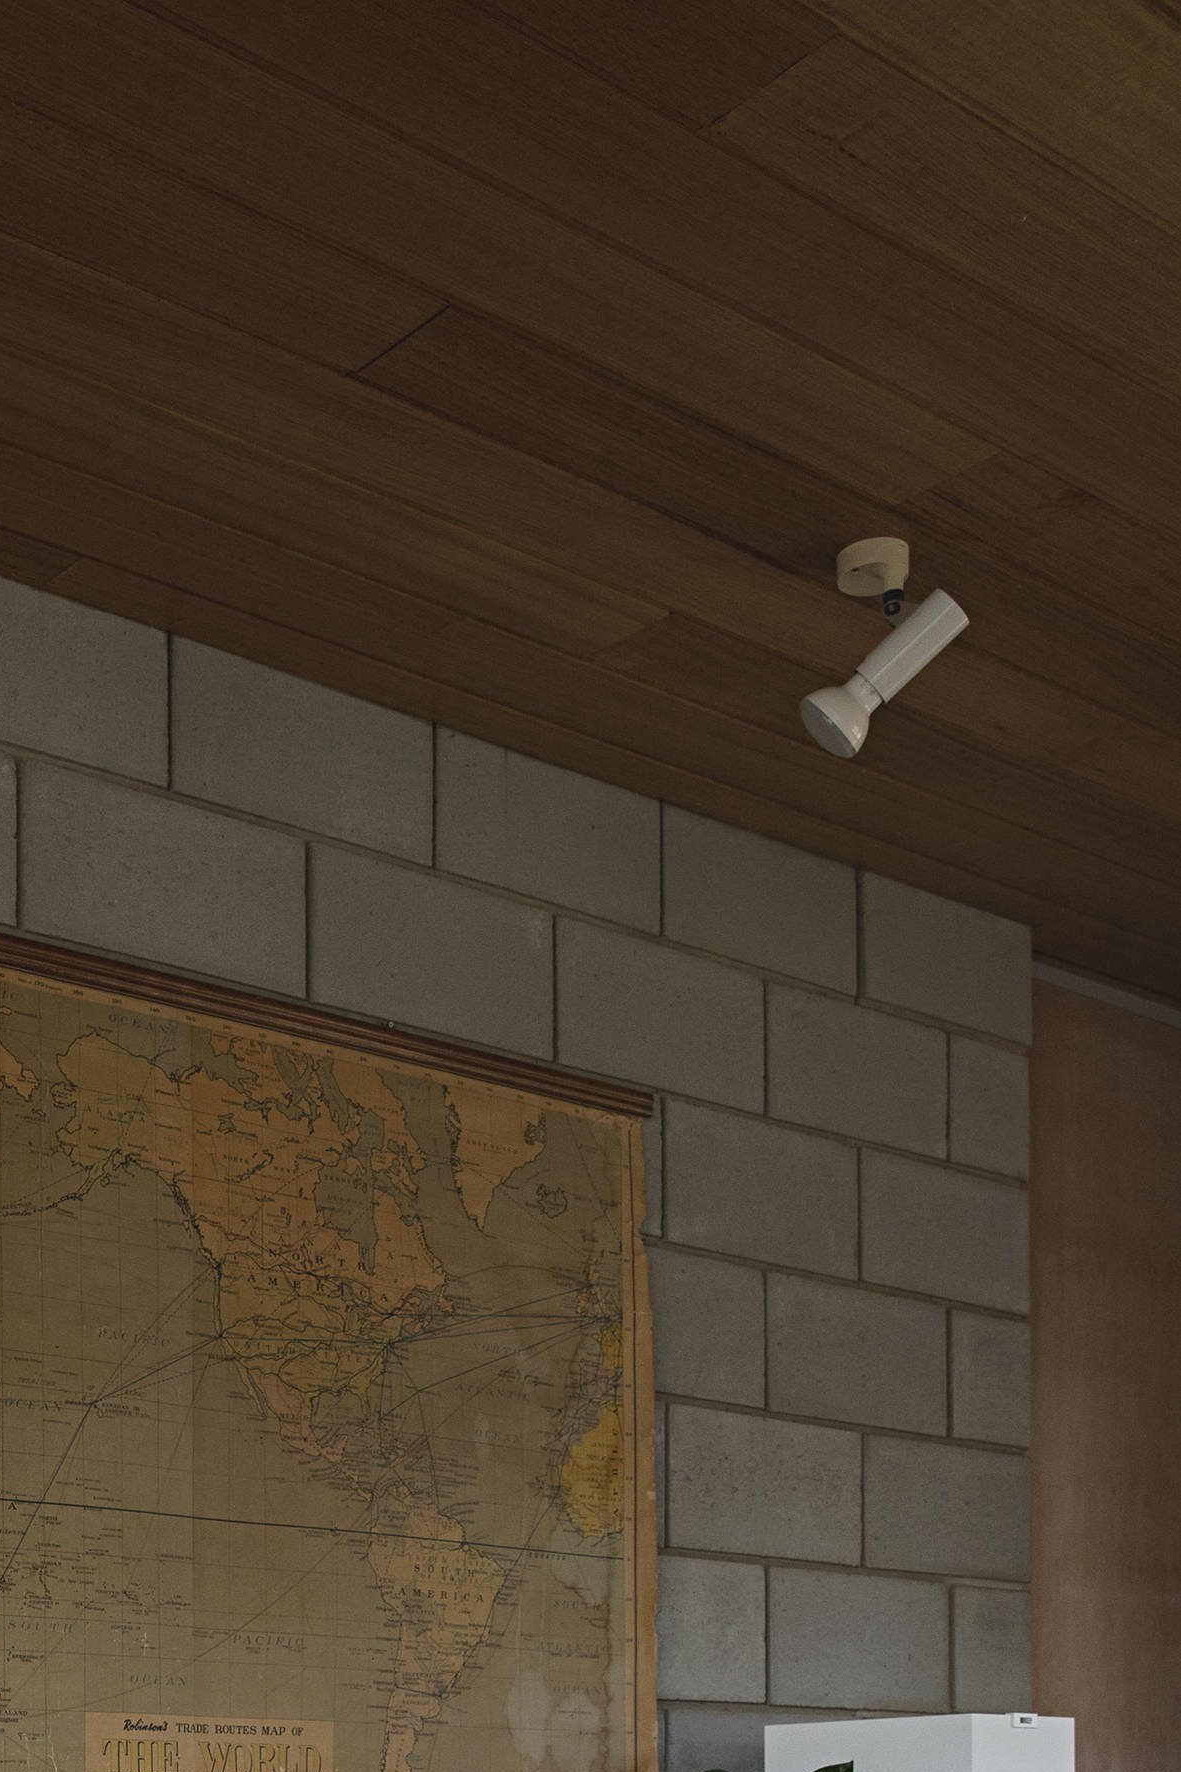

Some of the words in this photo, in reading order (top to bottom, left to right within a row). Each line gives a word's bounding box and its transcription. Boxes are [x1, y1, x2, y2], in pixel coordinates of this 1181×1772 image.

[176, 1723, 209, 1733] TRADE
[215, 1724, 257, 1735] ROUTES
[262, 1726, 286, 1736] MAP
[291, 1727, 304, 1736] OF
